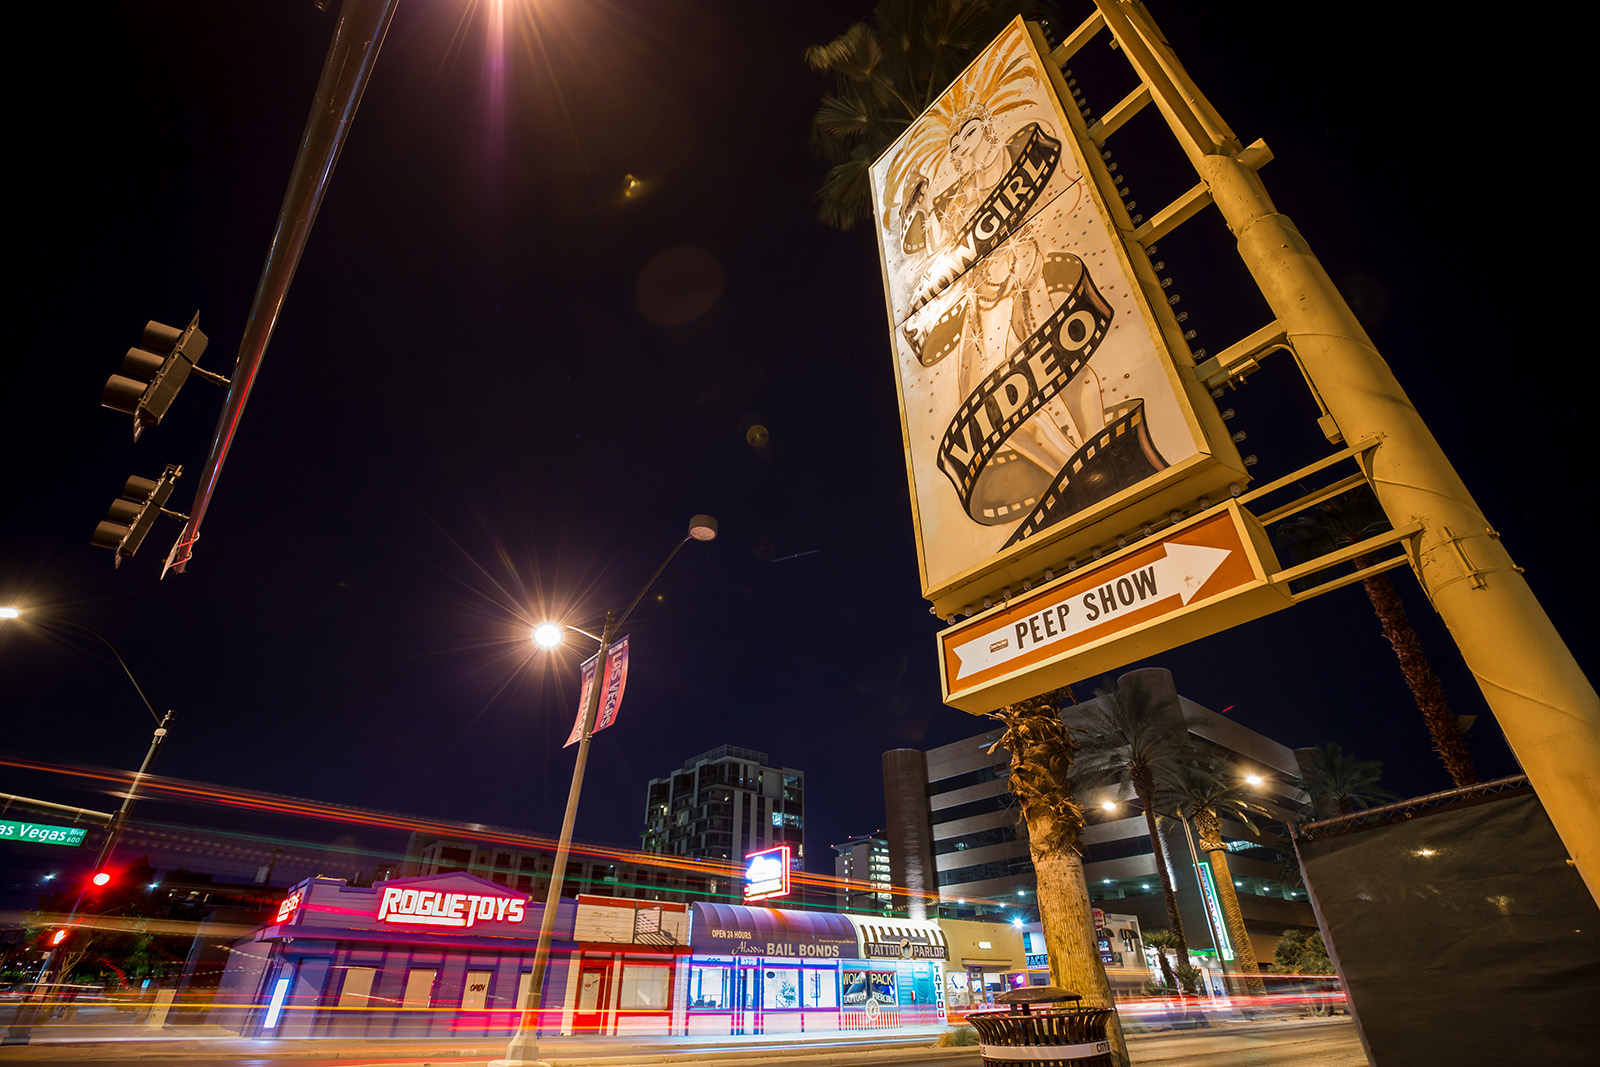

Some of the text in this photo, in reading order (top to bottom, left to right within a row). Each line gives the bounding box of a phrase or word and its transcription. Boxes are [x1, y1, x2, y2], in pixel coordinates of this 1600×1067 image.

[950, 309, 1096, 468] VIDEO
[1015, 566, 1158, 650] PEEP SHOW
[20, 824, 67, 842] Vegas
[712, 929, 752, 940] OPEN 24 HOURS
[766, 943, 795, 956] BAIL
[799, 944, 840, 958] BONDS
[868, 944, 945, 958] TATTOO PARLOR
[843, 973, 893, 986] WOLF PACK
[933, 965, 945, 1018] TATTOO
